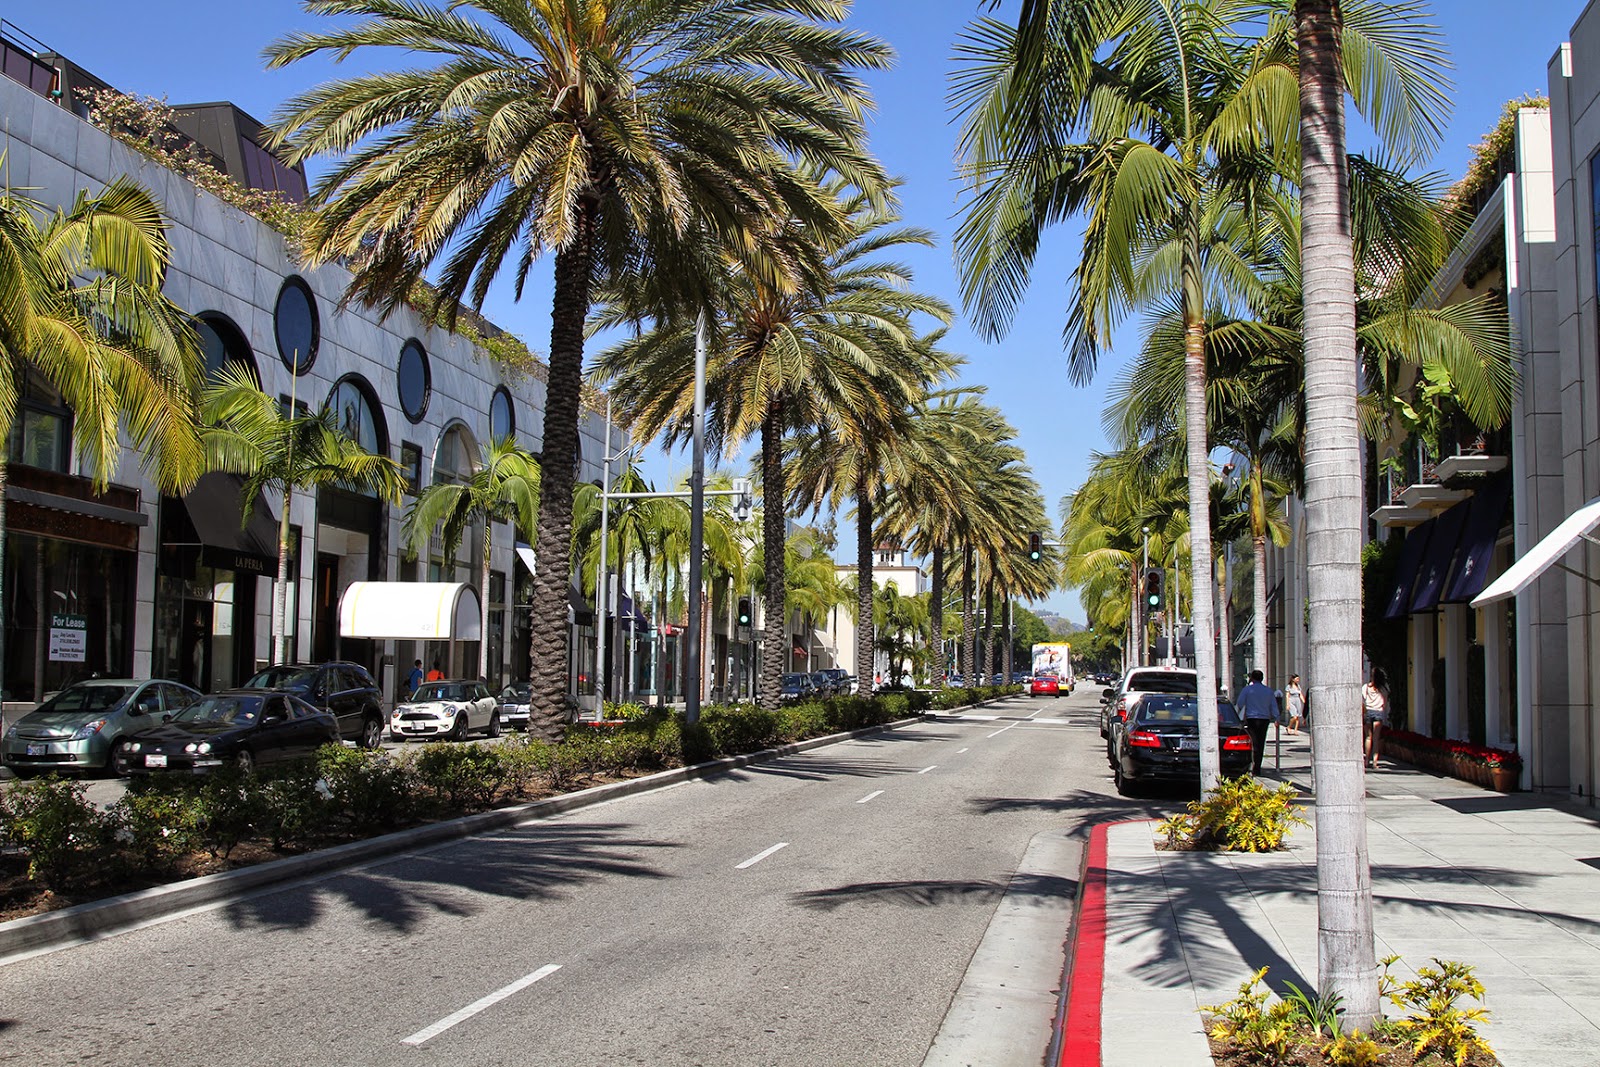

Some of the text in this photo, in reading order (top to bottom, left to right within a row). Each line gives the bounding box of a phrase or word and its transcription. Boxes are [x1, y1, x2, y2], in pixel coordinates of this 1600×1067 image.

[235, 556, 264, 571] LA PERLA
[53, 616, 85, 627] For Lease
